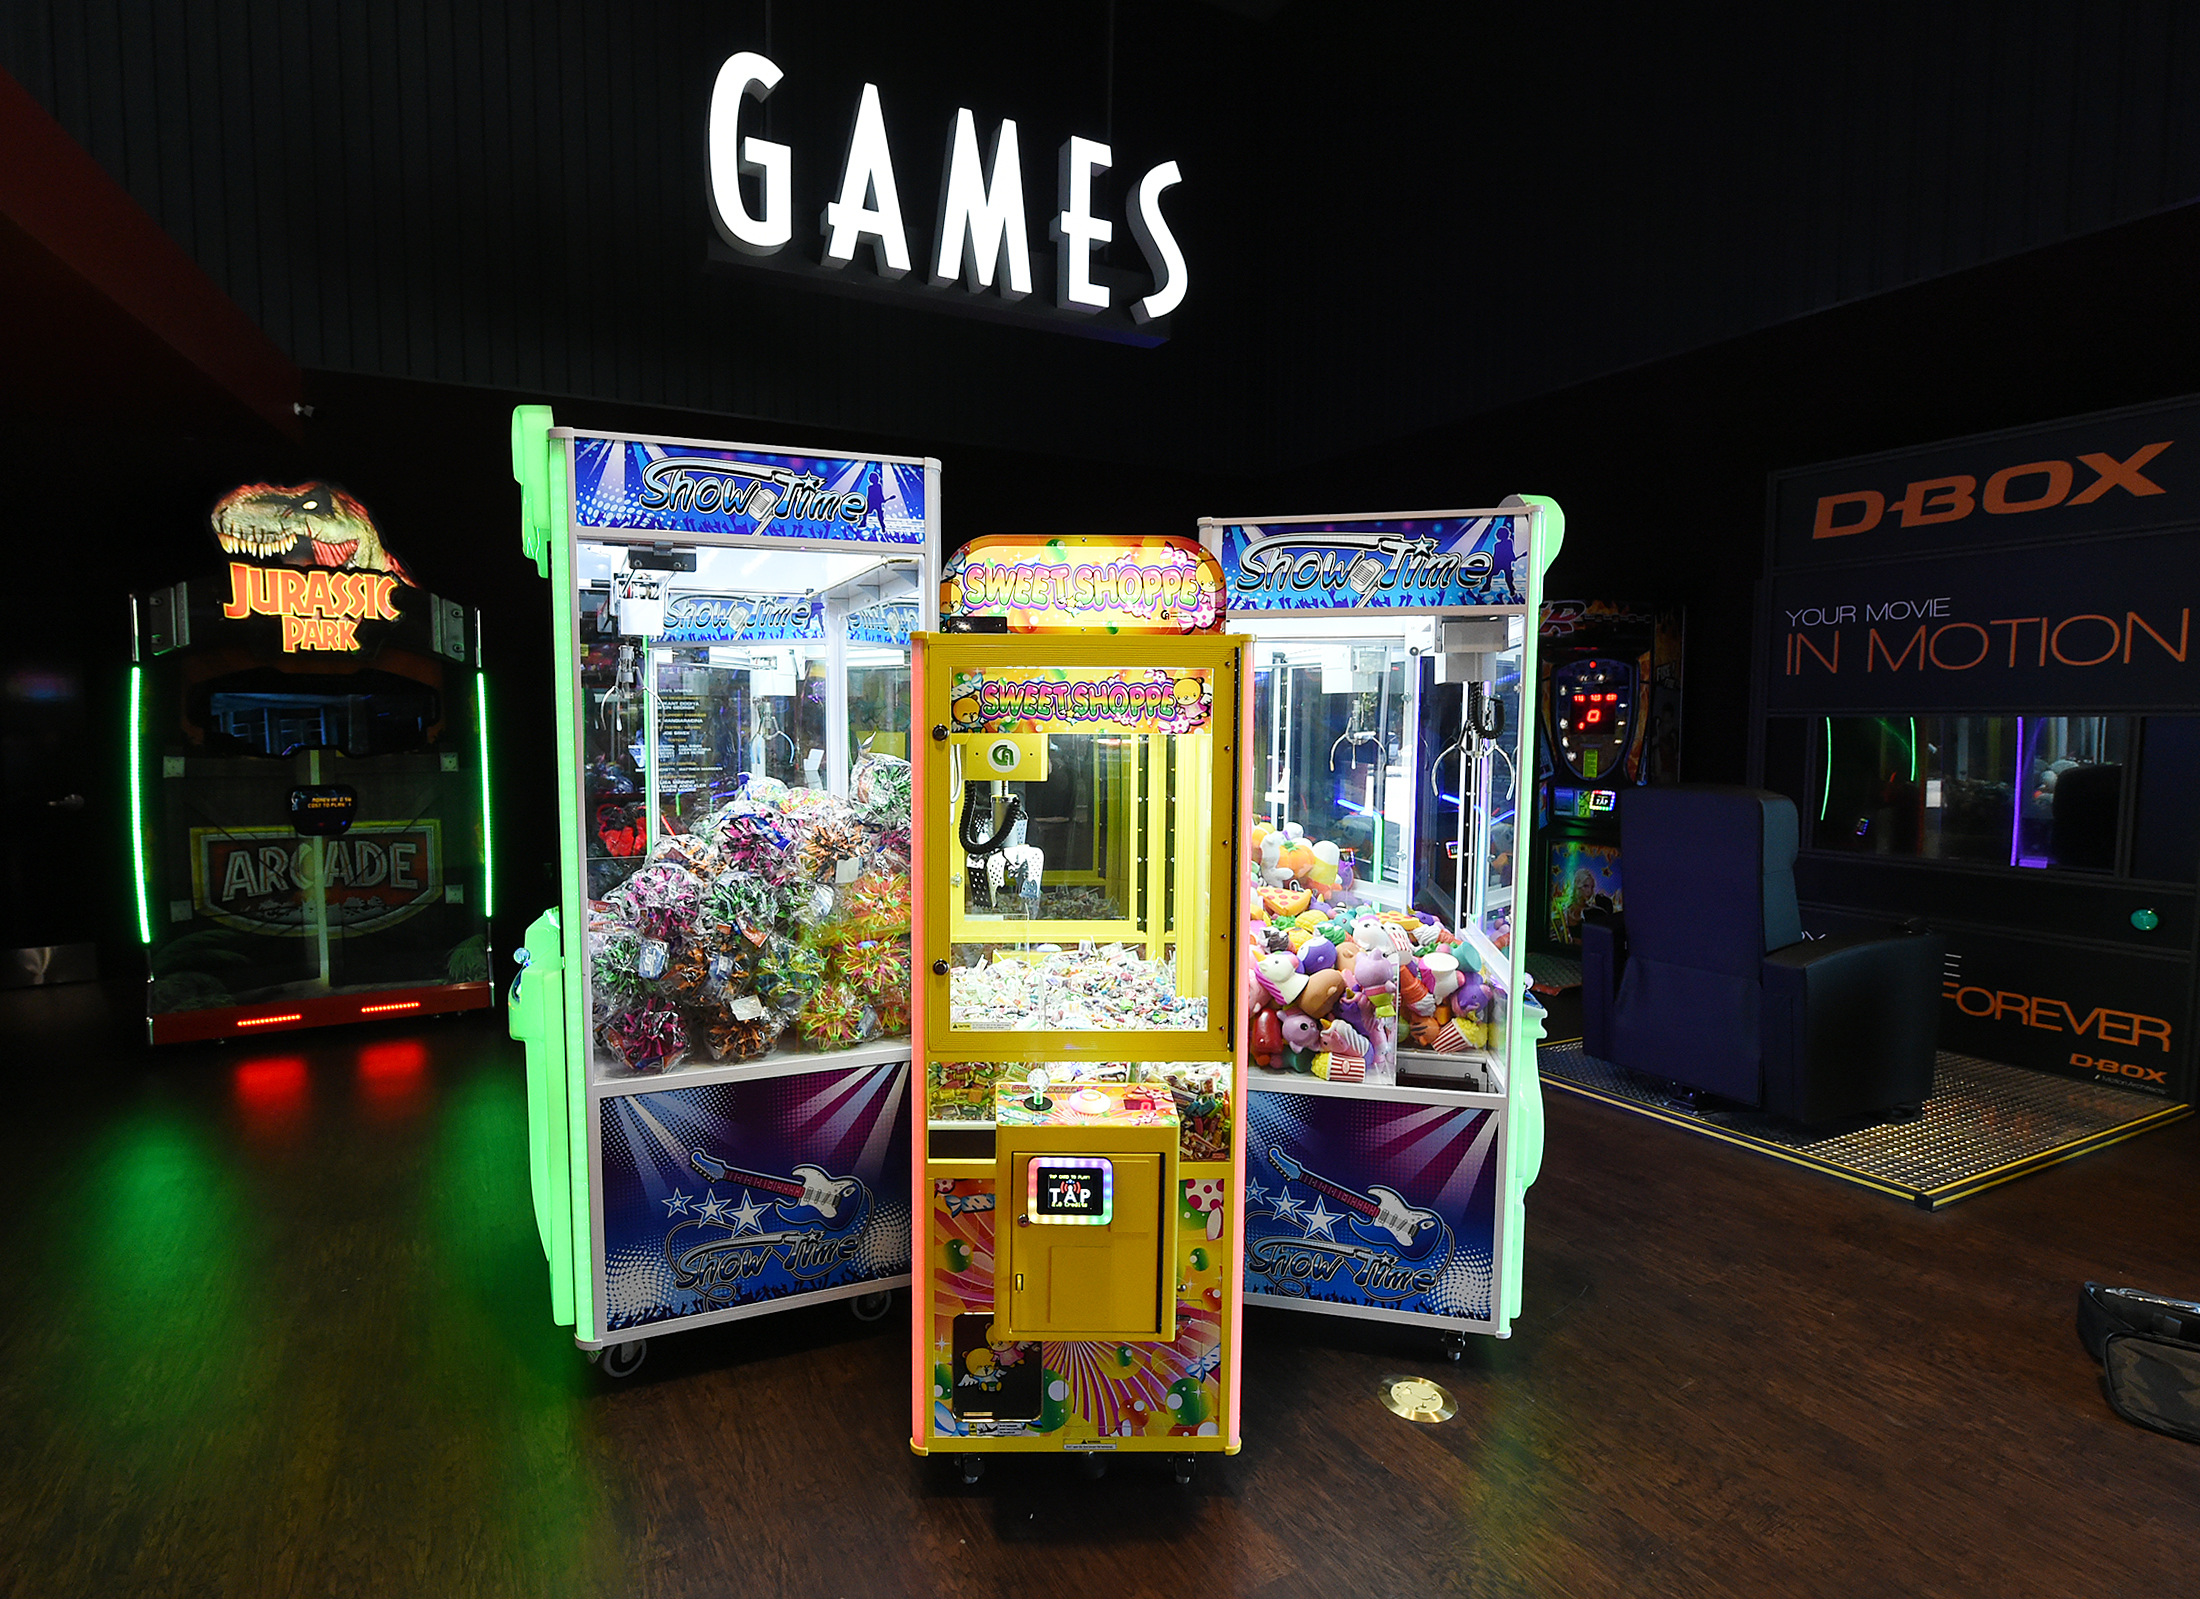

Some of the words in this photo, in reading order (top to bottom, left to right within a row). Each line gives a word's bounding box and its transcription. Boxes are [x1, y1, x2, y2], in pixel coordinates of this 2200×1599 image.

[707, 51, 1189, 321] GAMES
[639, 457, 757, 515] Show
[769, 469, 868, 523] Time
[1812, 440, 2175, 539] D-BOX
[223, 562, 399, 621] JURASSIC
[962, 562, 1072, 612] SWEET
[1072, 562, 1202, 612] SHOPPE
[1235, 532, 1354, 593] Show
[1378, 535, 1493, 591] Time
[281, 615, 361, 653] PARK
[1786, 605, 1857, 627] YOUR
[1866, 597, 1951, 622] MOVIE
[1786, 630, 1839, 675] IN
[1867, 608, 2190, 673] MOTION
[980, 679, 1070, 722] SWEET
[1070, 679, 1177, 722] SHOPPE
[221, 841, 418, 900] ARCADE
[2069, 1052, 2168, 1085] D-BOX
[1049, 1184, 1091, 1206] TAP
